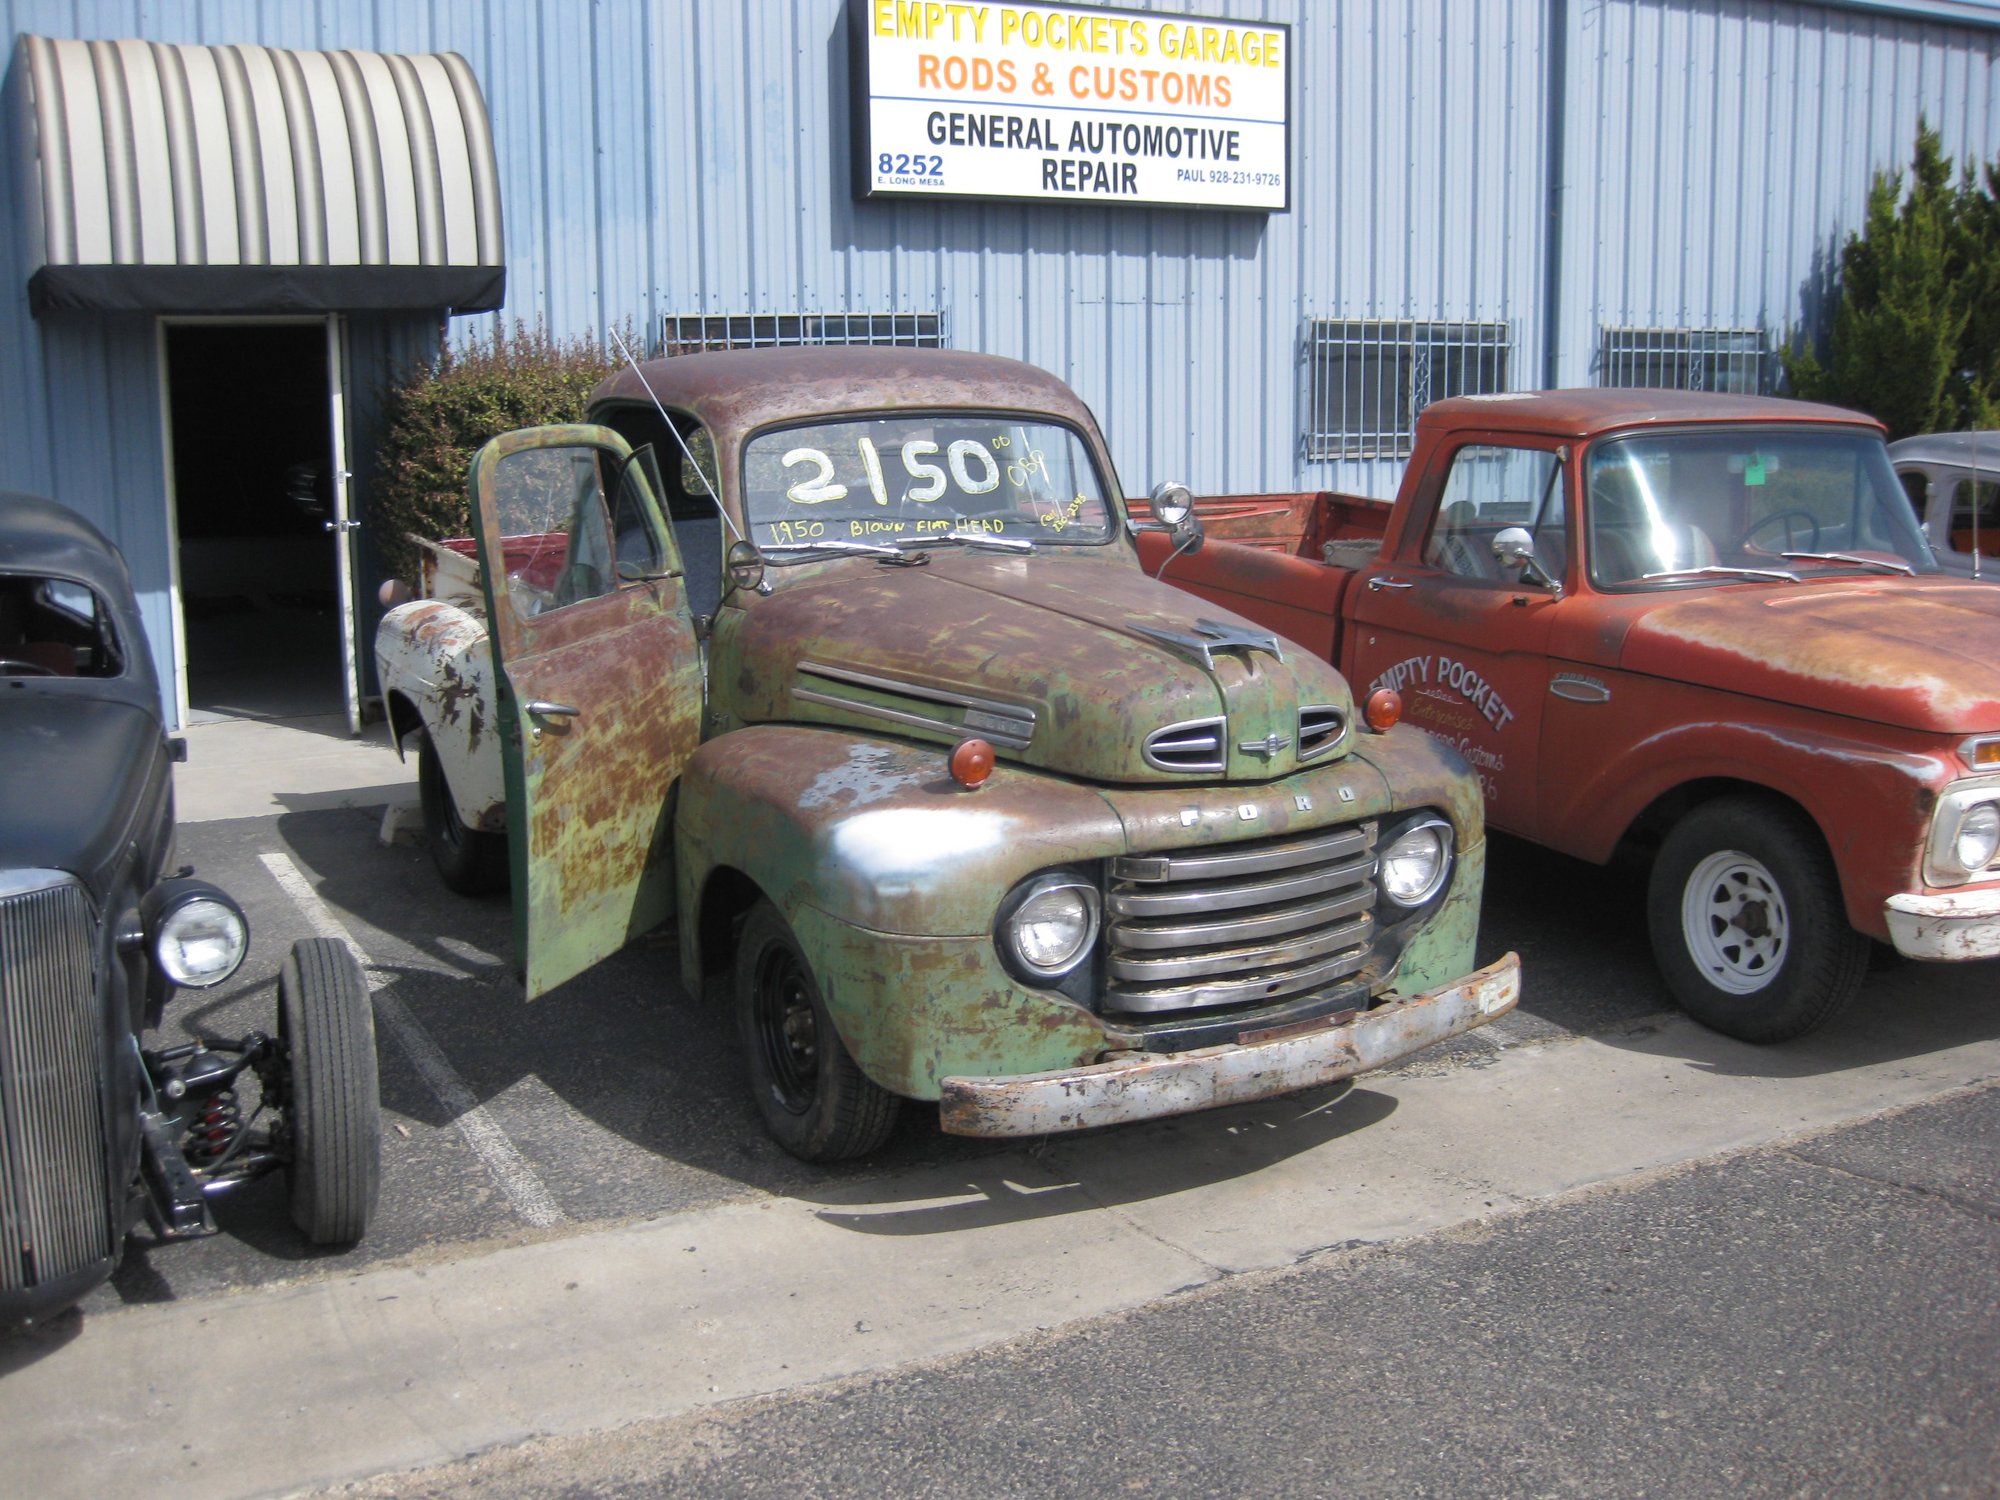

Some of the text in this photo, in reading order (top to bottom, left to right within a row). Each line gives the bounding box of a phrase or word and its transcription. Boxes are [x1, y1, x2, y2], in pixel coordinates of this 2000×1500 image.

[873, 0, 1280, 68] EMPTY POCKETS GARAGE
[918, 54, 1232, 108] RODS & CUSTOMS
[927, 111, 1240, 161] GENERAL AUTOMOTIVE
[877, 176, 946, 187] E. LONG MESA
[878, 153, 944, 177] 8252
[1042, 158, 1138, 195] REPAIR
[1177, 168, 1281, 187] PAUL 928-231-9726
[781, 437, 1000, 506] 2150
[769, 520, 825, 546] 1950
[955, 518, 1004, 534] HEAD
[1437, 656, 1513, 732] POCKET
[1180, 787, 1355, 828] FORD
